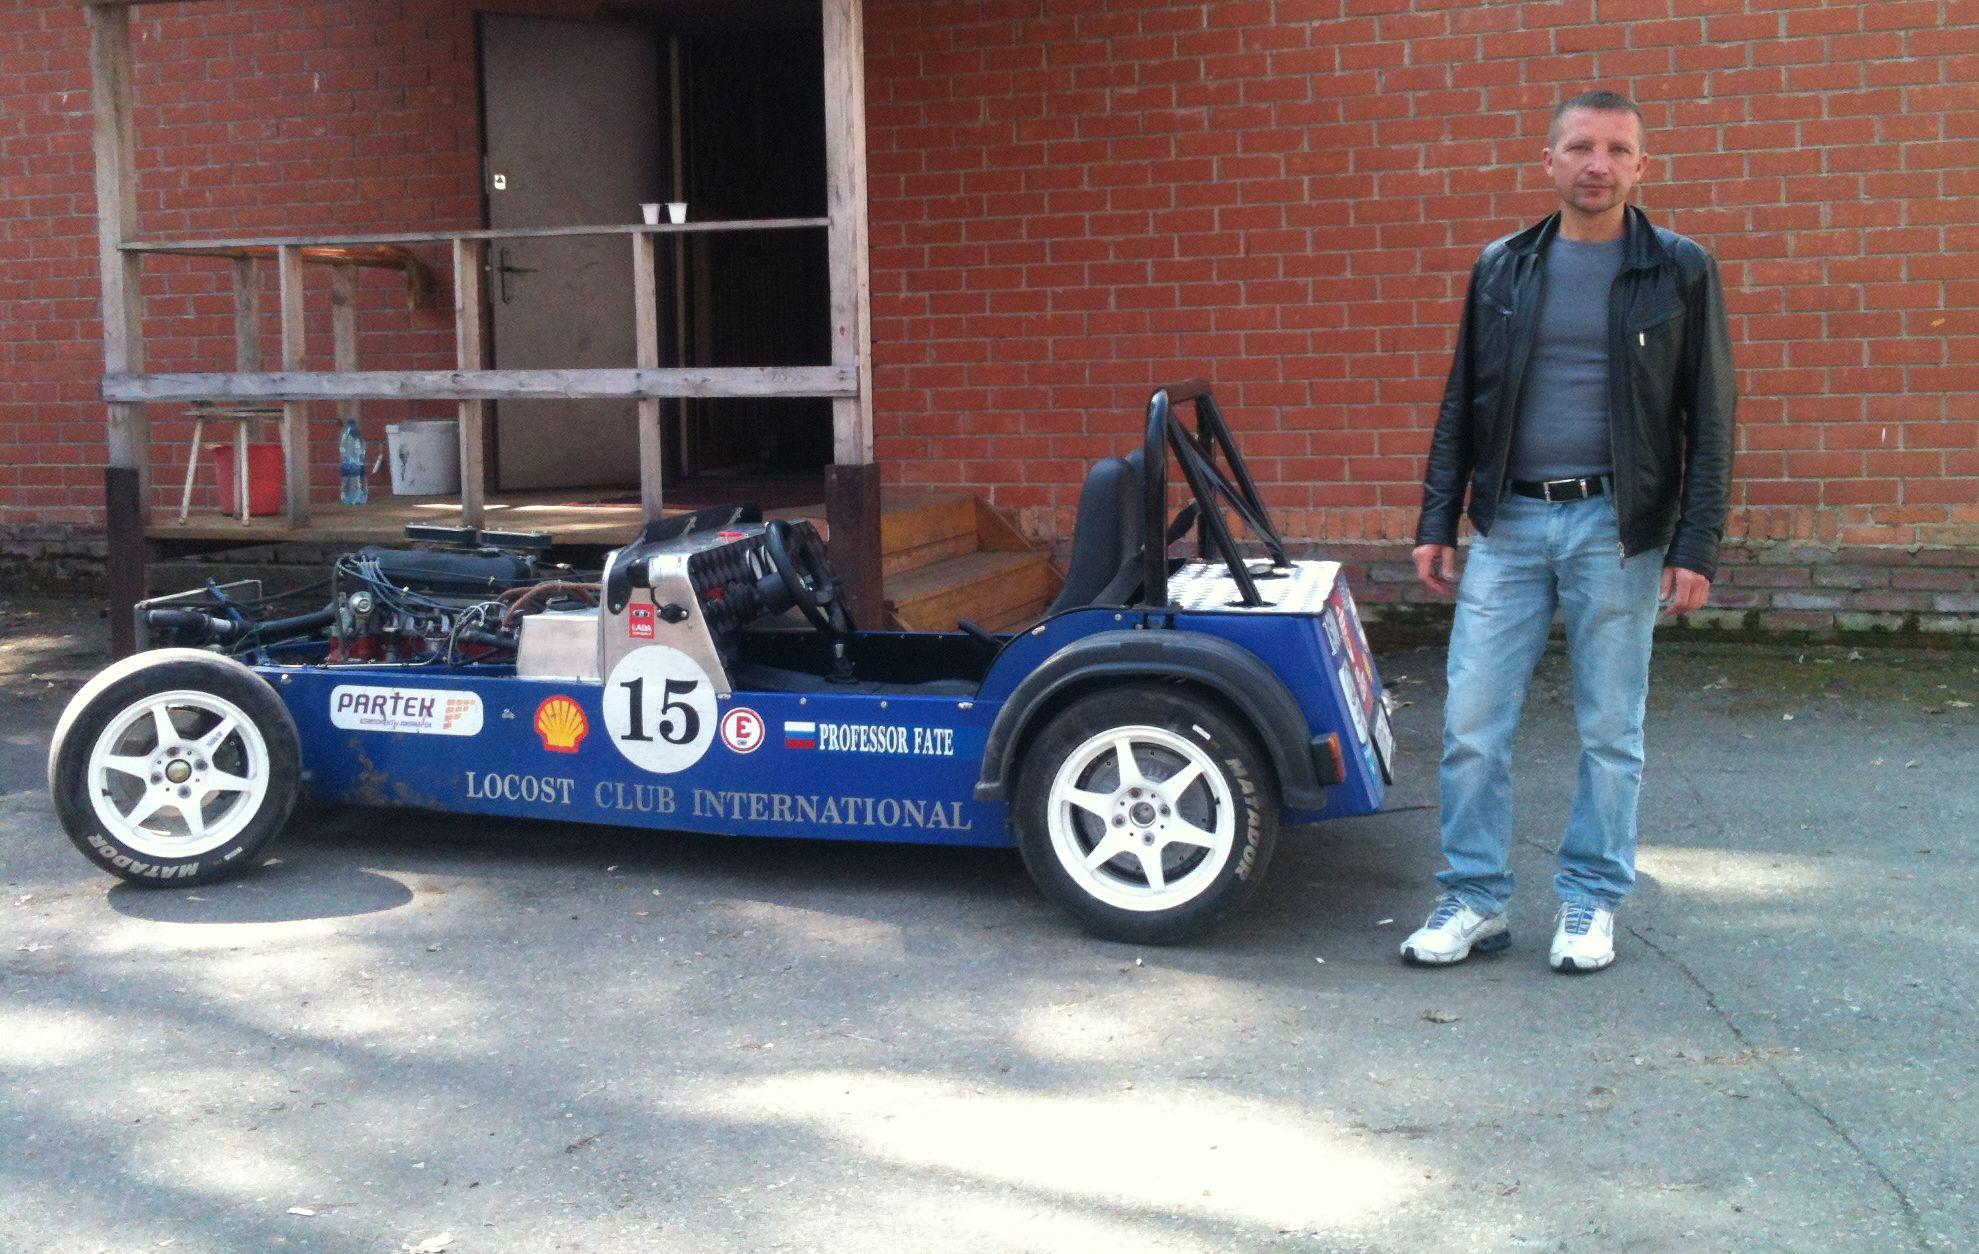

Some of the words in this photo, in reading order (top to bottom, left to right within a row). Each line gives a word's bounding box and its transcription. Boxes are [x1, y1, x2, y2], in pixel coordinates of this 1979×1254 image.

[337, 692, 436, 719] PARTEK
[619, 677, 699, 744] 15
[736, 716, 751, 738] E
[819, 723, 909, 754] PROFESSOR
[913, 727, 954, 755] FATE
[465, 771, 575, 804] LOCOST
[594, 781, 676, 814] CLUB
[692, 789, 972, 830] INTERNATIONAL
[87, 833, 199, 879] MATADOR
